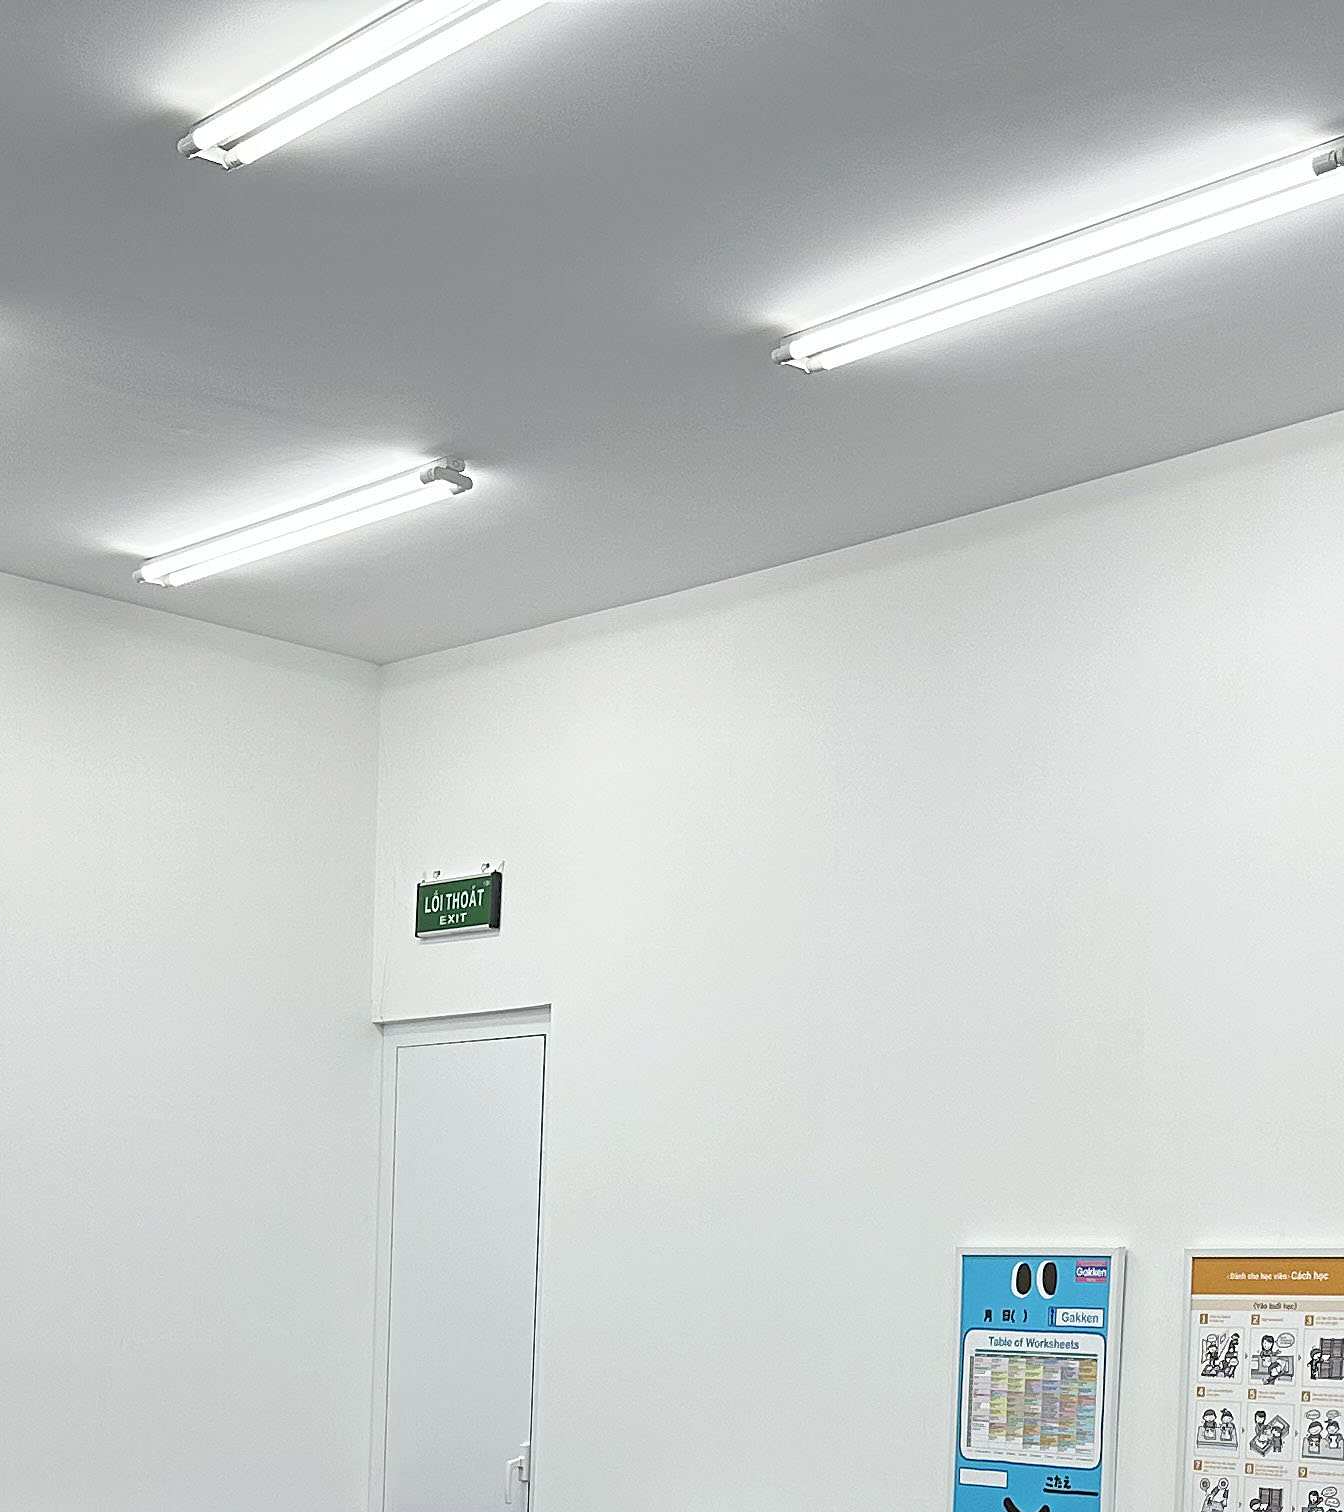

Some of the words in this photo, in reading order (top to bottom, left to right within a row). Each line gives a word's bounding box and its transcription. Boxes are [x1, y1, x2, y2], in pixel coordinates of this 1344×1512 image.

[424, 890, 443, 913] LỐI
[446, 885, 485, 911] THOÁT
[439, 913, 467, 925] EXIT
[1061, 1312, 1099, 1323] Gakken
[988, 1336, 1012, 1347] Table
[1016, 1337, 1024, 1347] of
[1026, 1338, 1080, 1350] Worksheets
[1045, 1475, 1071, 1489] こたえ
